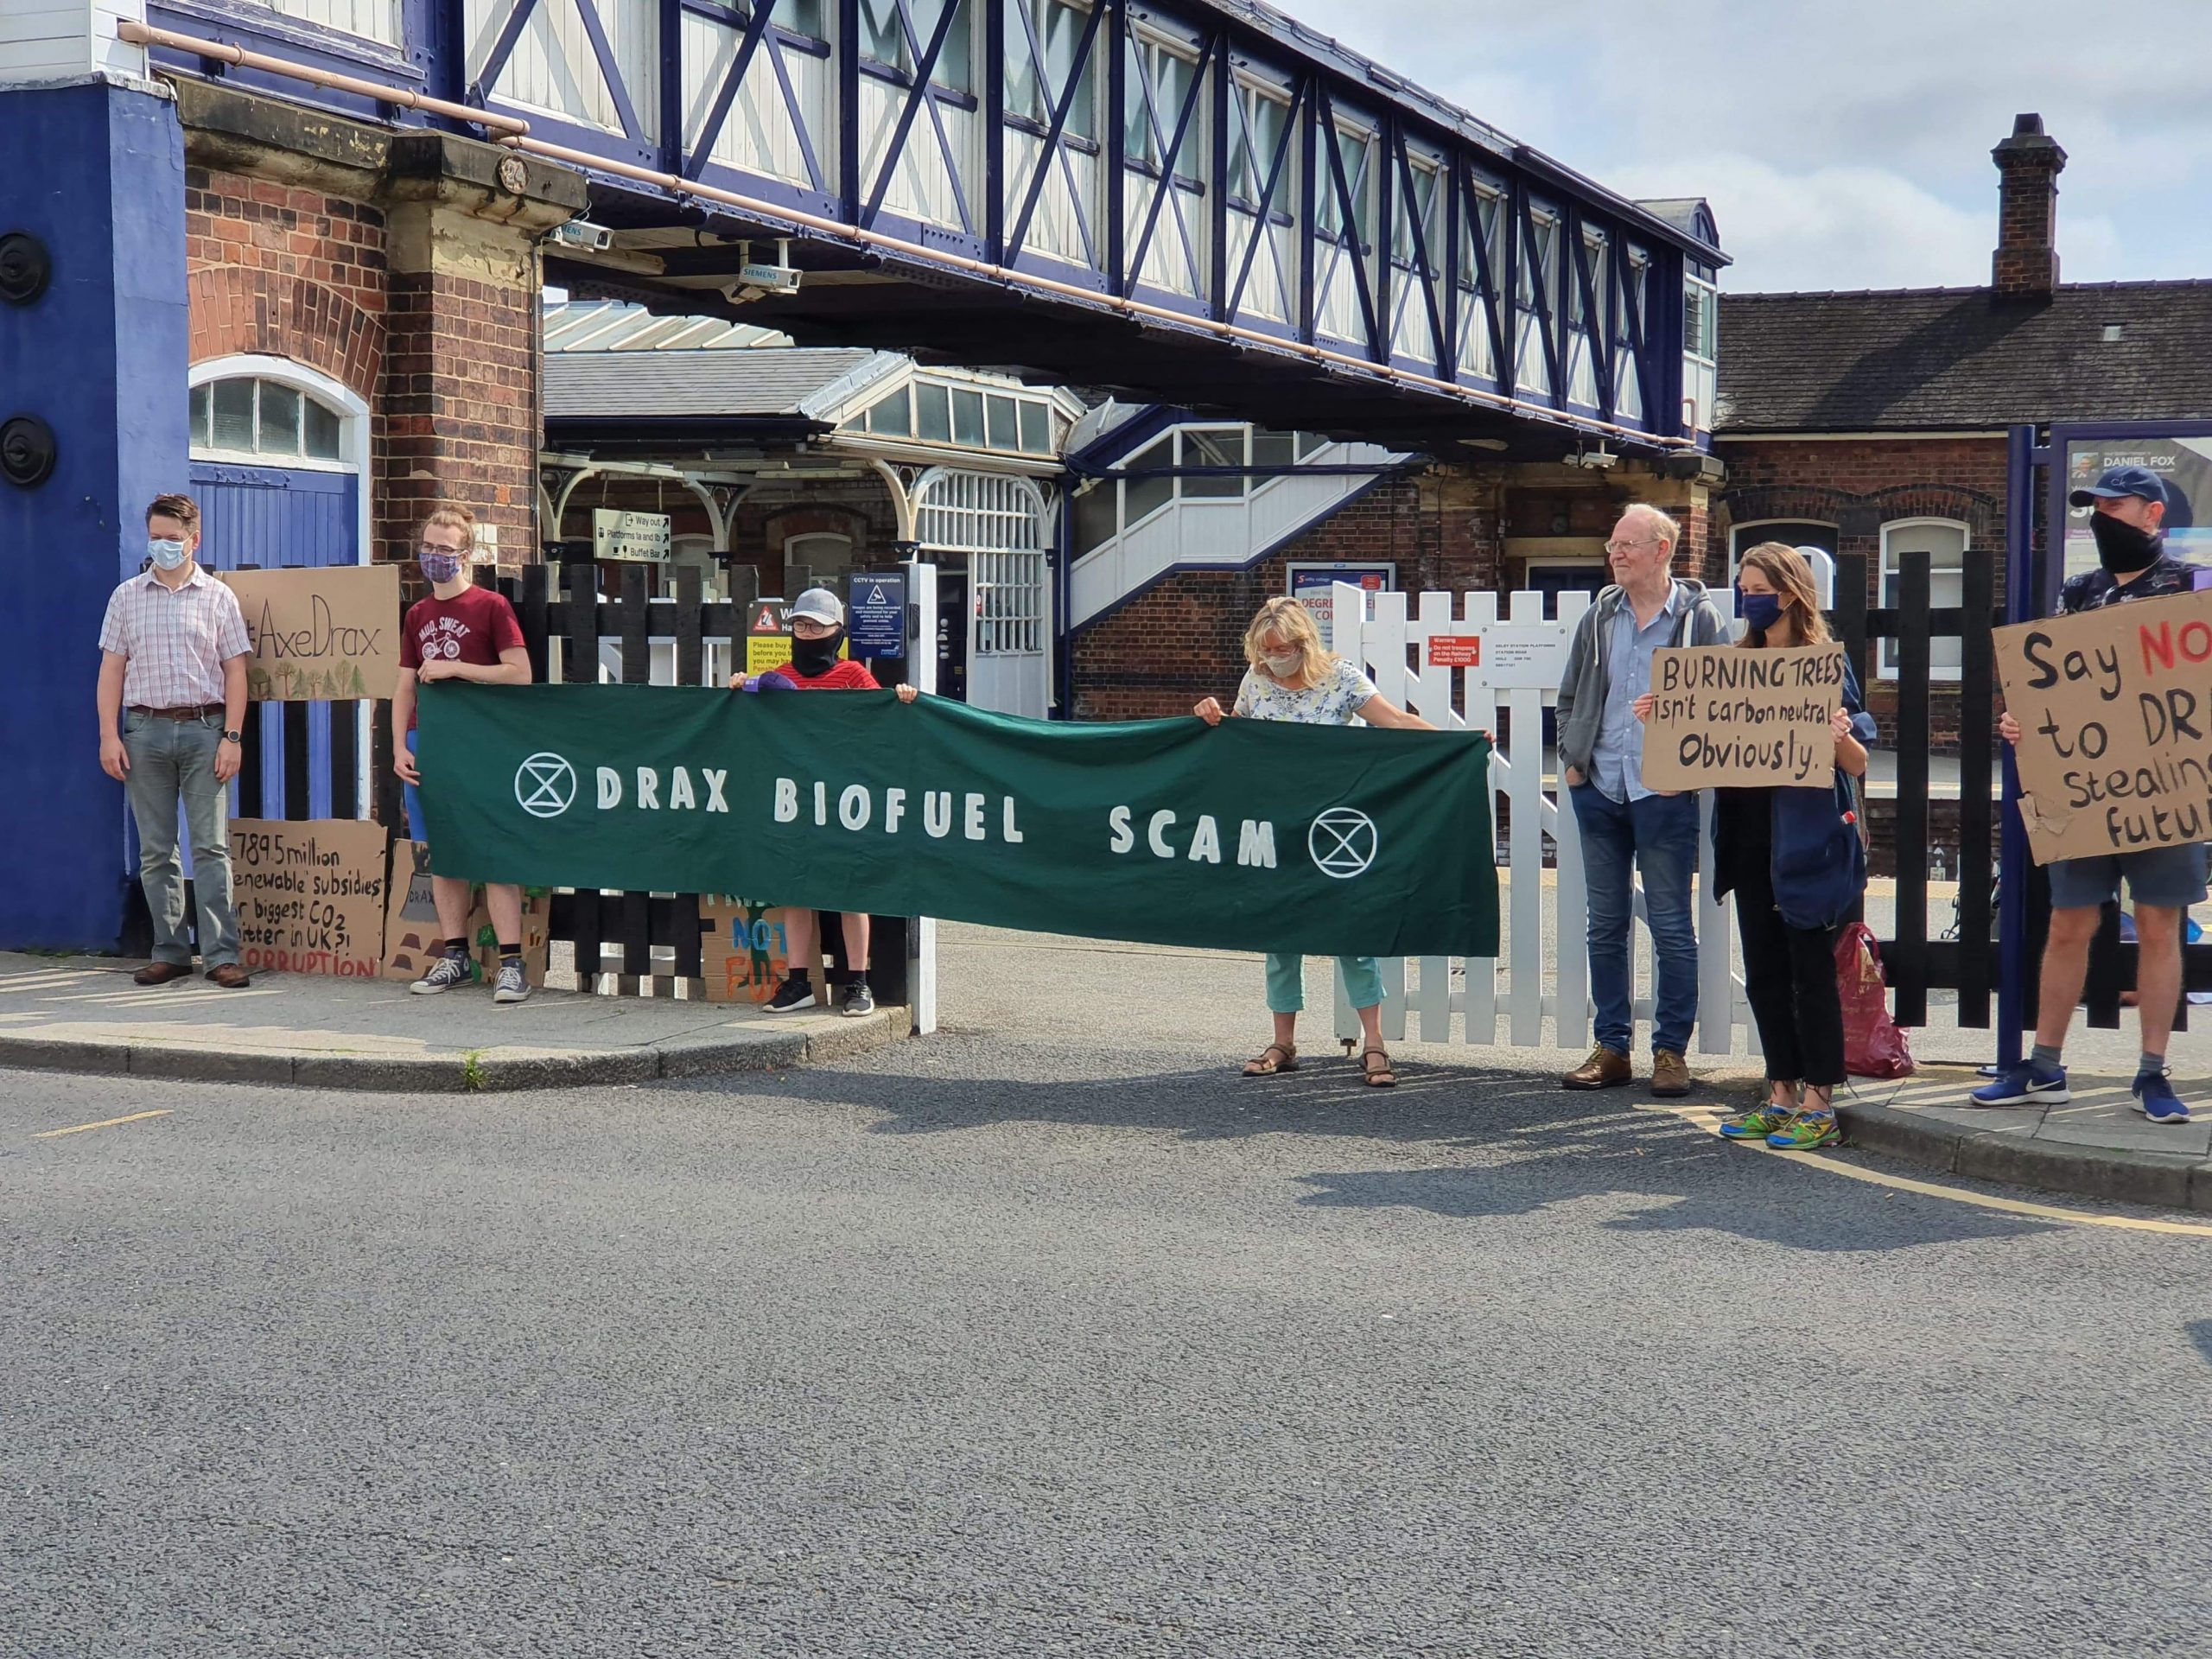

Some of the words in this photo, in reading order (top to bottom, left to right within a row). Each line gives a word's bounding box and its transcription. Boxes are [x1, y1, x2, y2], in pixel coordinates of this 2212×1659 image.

[744, 269, 777, 279] SIEMENS
[2103, 456, 2148, 467] DANIEL
[2150, 455, 2176, 466] FOX
[607, 530, 635, 540] Platforms
[636, 516, 650, 527] Way
[631, 548, 649, 557] Buffet
[650, 549, 660, 558] Bar
[1301, 598, 1333, 608] DEGRE
[418, 620, 438, 642] MUD,
[438, 616, 471, 639] SWEAT
[1662, 655, 1786, 691] BURNING
[1789, 652, 1842, 688] TREES
[2023, 632, 2121, 701] Say
[2139, 620, 2212, 677] NO
[1654, 694, 1696, 728] isn't
[1707, 696, 1775, 724] carbon
[1779, 696, 1833, 726] neutral
[2037, 707, 2108, 760] to
[2139, 688, 2212, 747] DR
[1679, 729, 1819, 780] Obviously.
[596, 766, 728, 813] DRAX
[774, 778, 1023, 842] BIOFUEL
[1109, 805, 1277, 869] SCAM
[287, 836, 340, 867] million
[233, 870, 308, 893] enewable'
[254, 898, 304, 925] biggest
[237, 922, 284, 945] itter
[291, 924, 302, 948] in
[732, 916, 787, 954] NOT
[238, 947, 379, 977] ORRUPTION
[726, 956, 788, 1001] FUE
